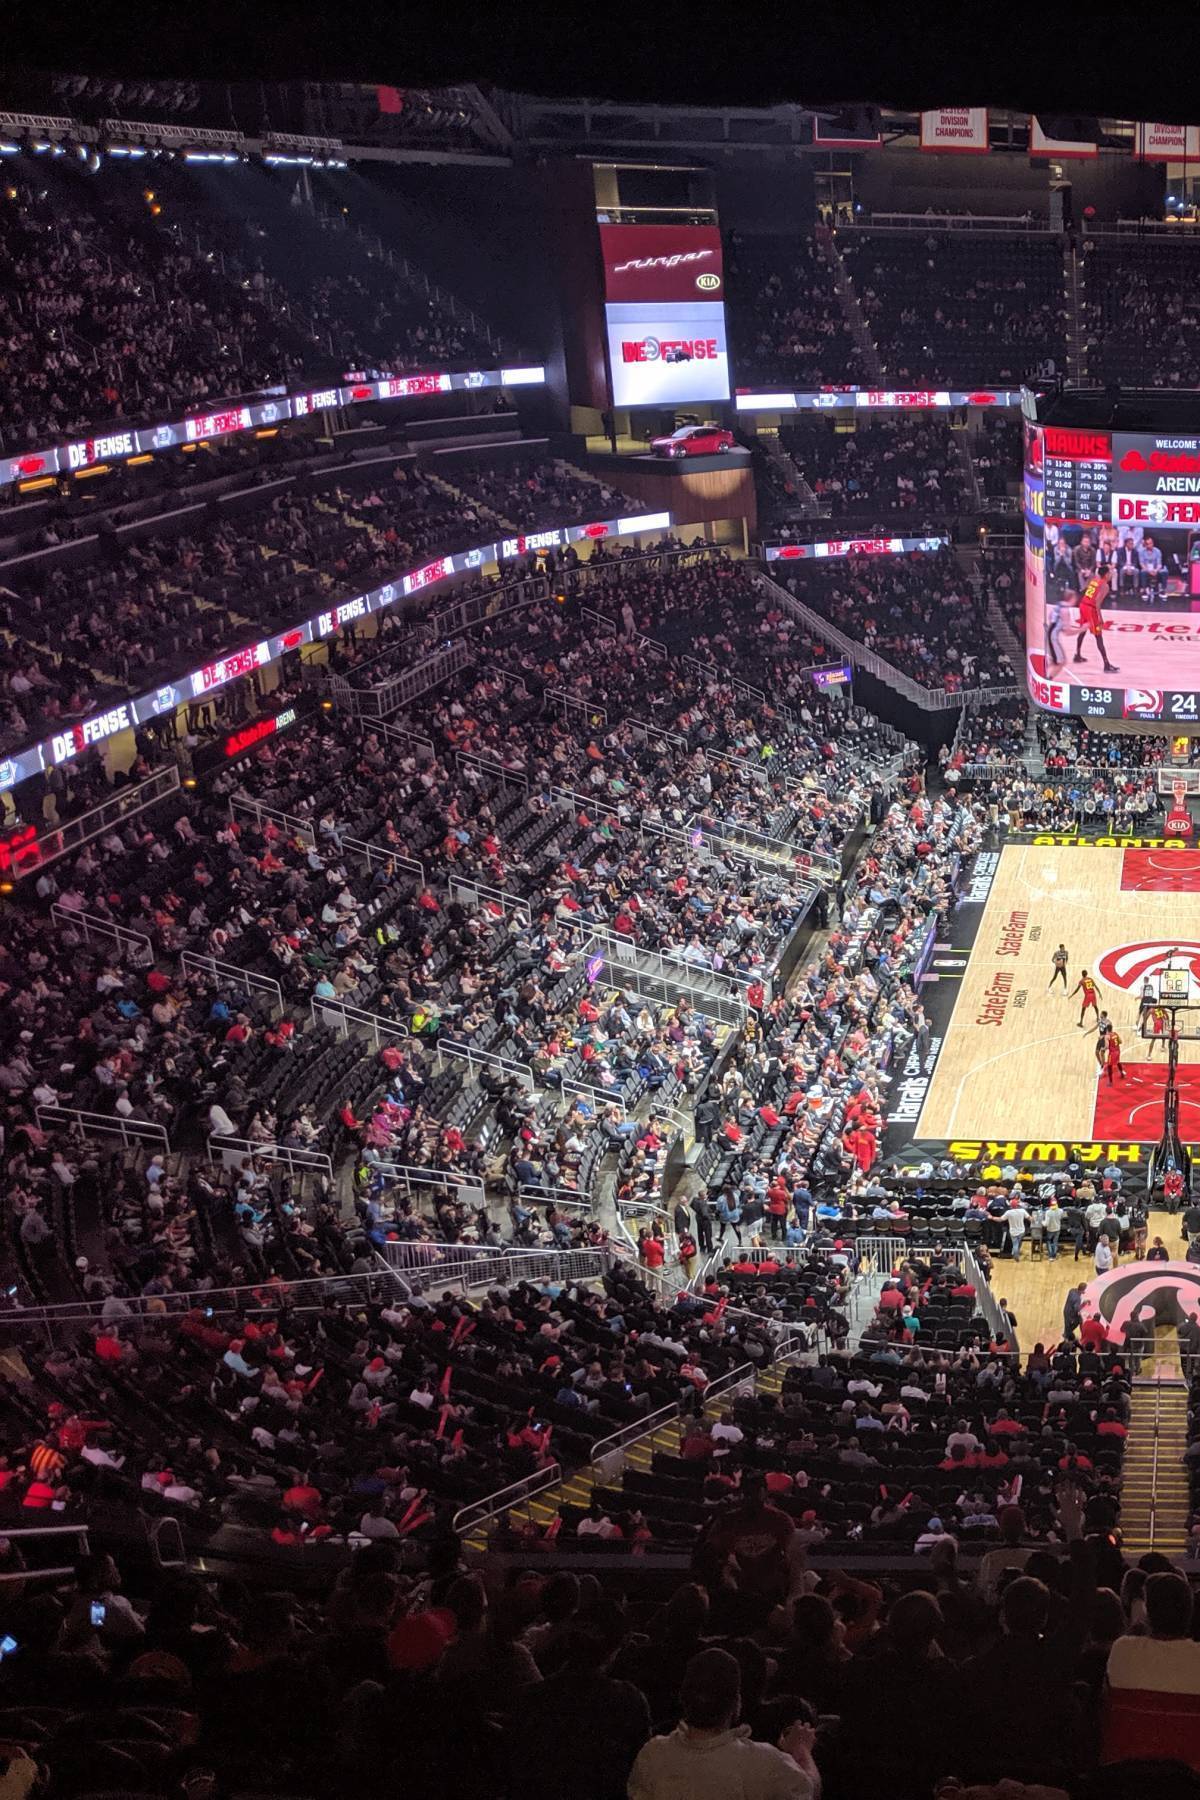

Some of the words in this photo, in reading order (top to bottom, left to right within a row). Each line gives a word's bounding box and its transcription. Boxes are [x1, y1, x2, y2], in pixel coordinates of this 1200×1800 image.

[940, 115, 969, 127] DIVISION
[935, 127, 974, 138] CHAMPIONS
[1154, 124, 1182, 134] DIVISION
[1149, 135, 1186, 147] CHAMPIONS
[699, 275, 717, 287] KIA
[1155, 439, 1197, 449] WELCOME
[68, 432, 133, 469] DEFENSE
[1054, 470, 1072, 478] 01-10
[1093, 473, 1107, 481] 10%
[1054, 481, 1072, 489] 01-02
[502, 530, 561, 559] DEFENSE
[1103, 620, 1191, 634] tate
[1080, 688, 1113, 704] 9:38
[1171, 693, 1197, 713] 24
[1087, 706, 1106, 715] 2ND
[51, 702, 130, 765] DEFENSE
[1171, 821, 1186, 829] KIA
[1032, 836, 1186, 848] ATLANTA
[886, 1077, 929, 1123] Harrah's
